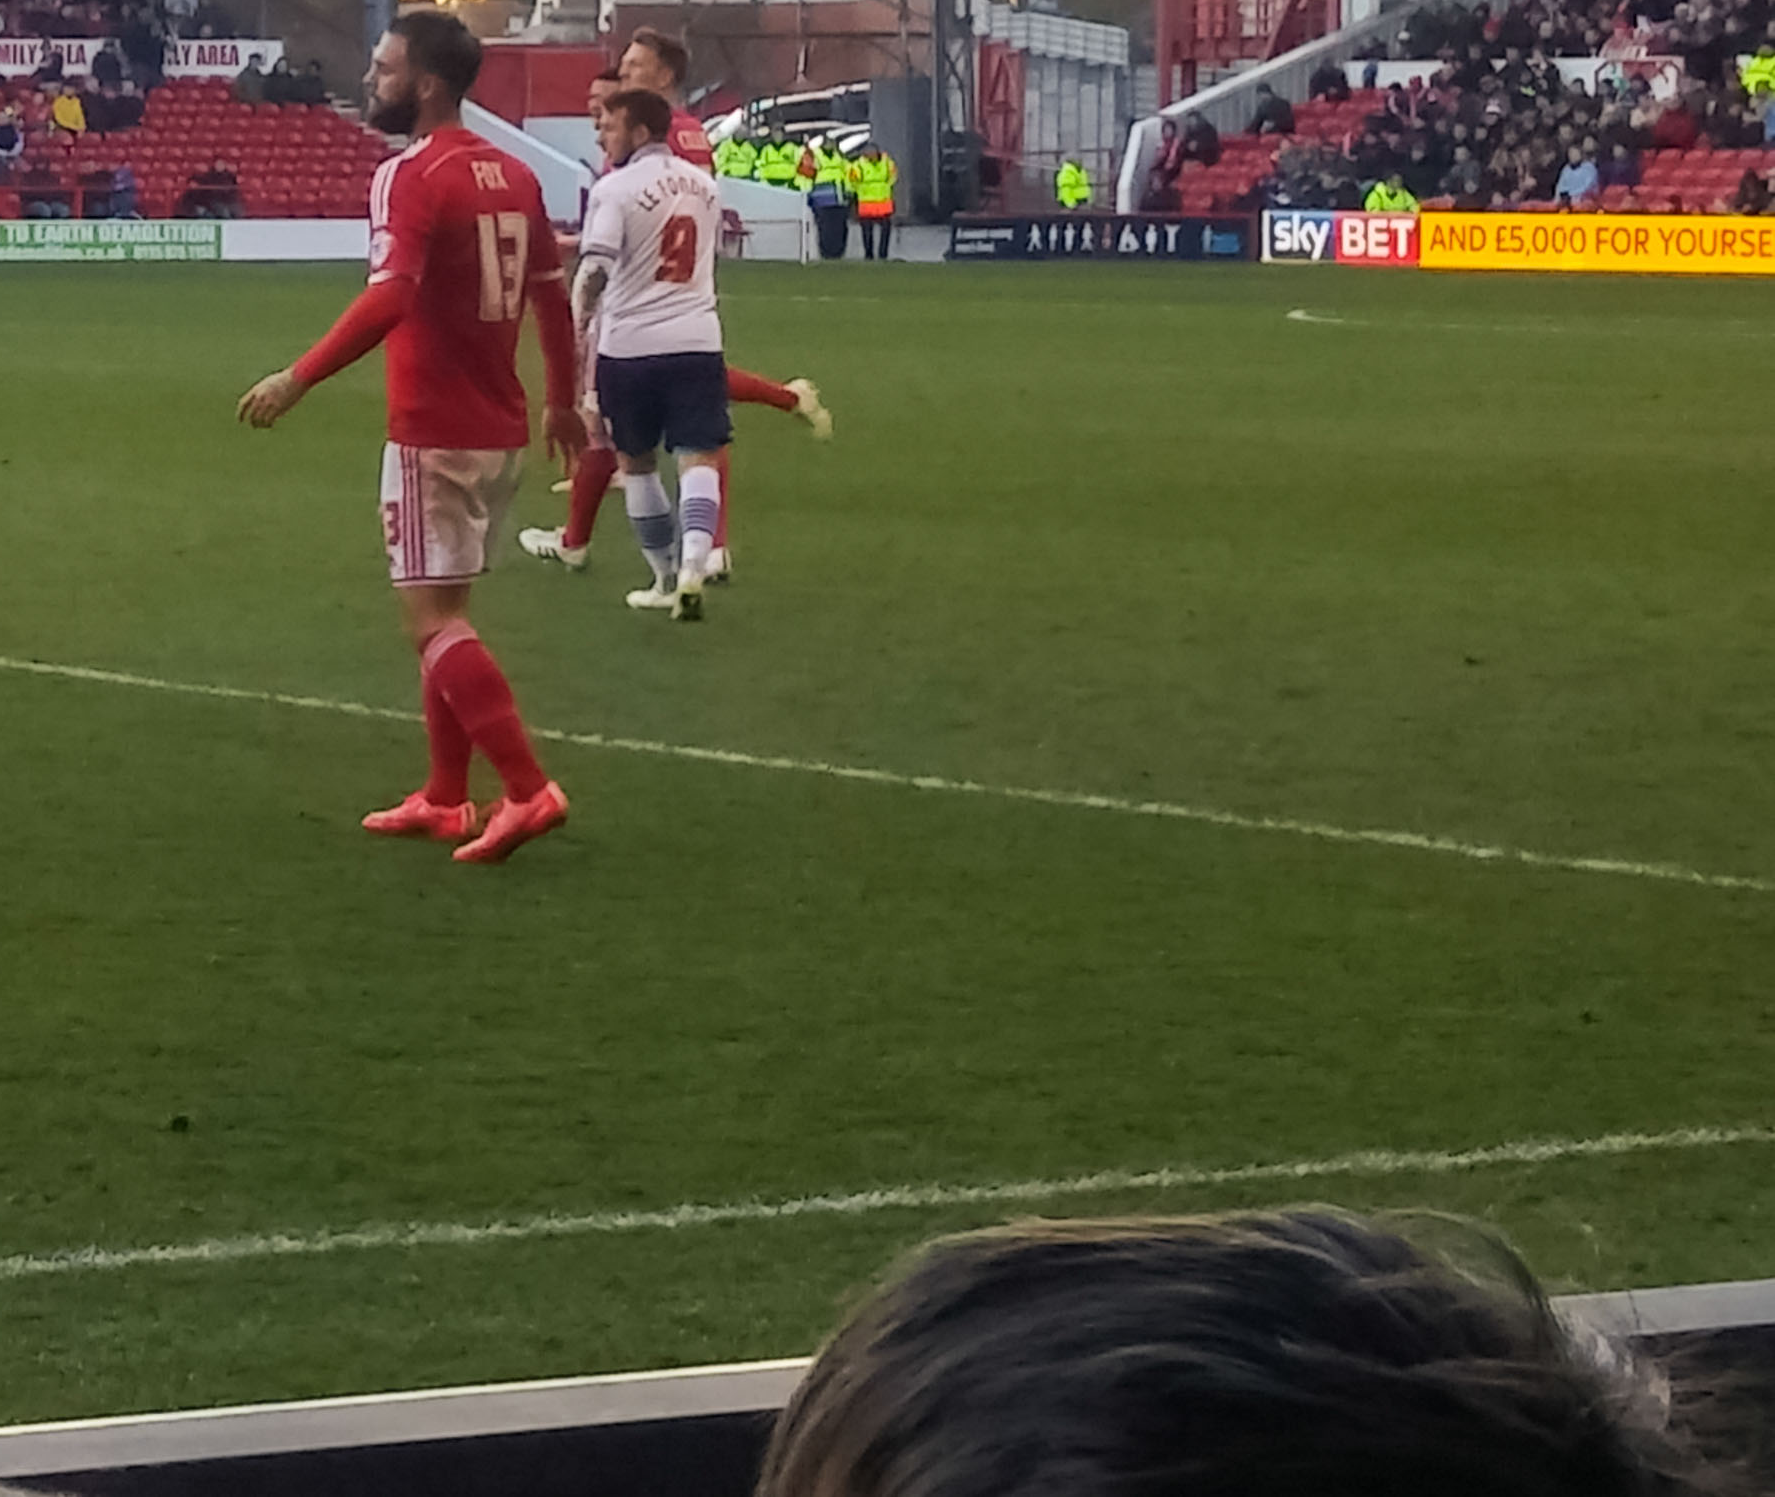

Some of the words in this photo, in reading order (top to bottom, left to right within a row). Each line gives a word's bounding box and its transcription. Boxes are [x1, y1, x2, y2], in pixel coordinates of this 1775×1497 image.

[196, 44, 240, 67] AREA
[471, 158, 510, 191] FOX
[99, 224, 215, 242] DEMOLITION
[654, 213, 698, 283] 9
[1273, 213, 1330, 262] sky
[1341, 217, 1415, 259] BET
[1430, 224, 1486, 252] AND
[1495, 225, 1587, 257] £5,000
[1595, 227, 1650, 255] FOR
[476, 211, 529, 322] 13
